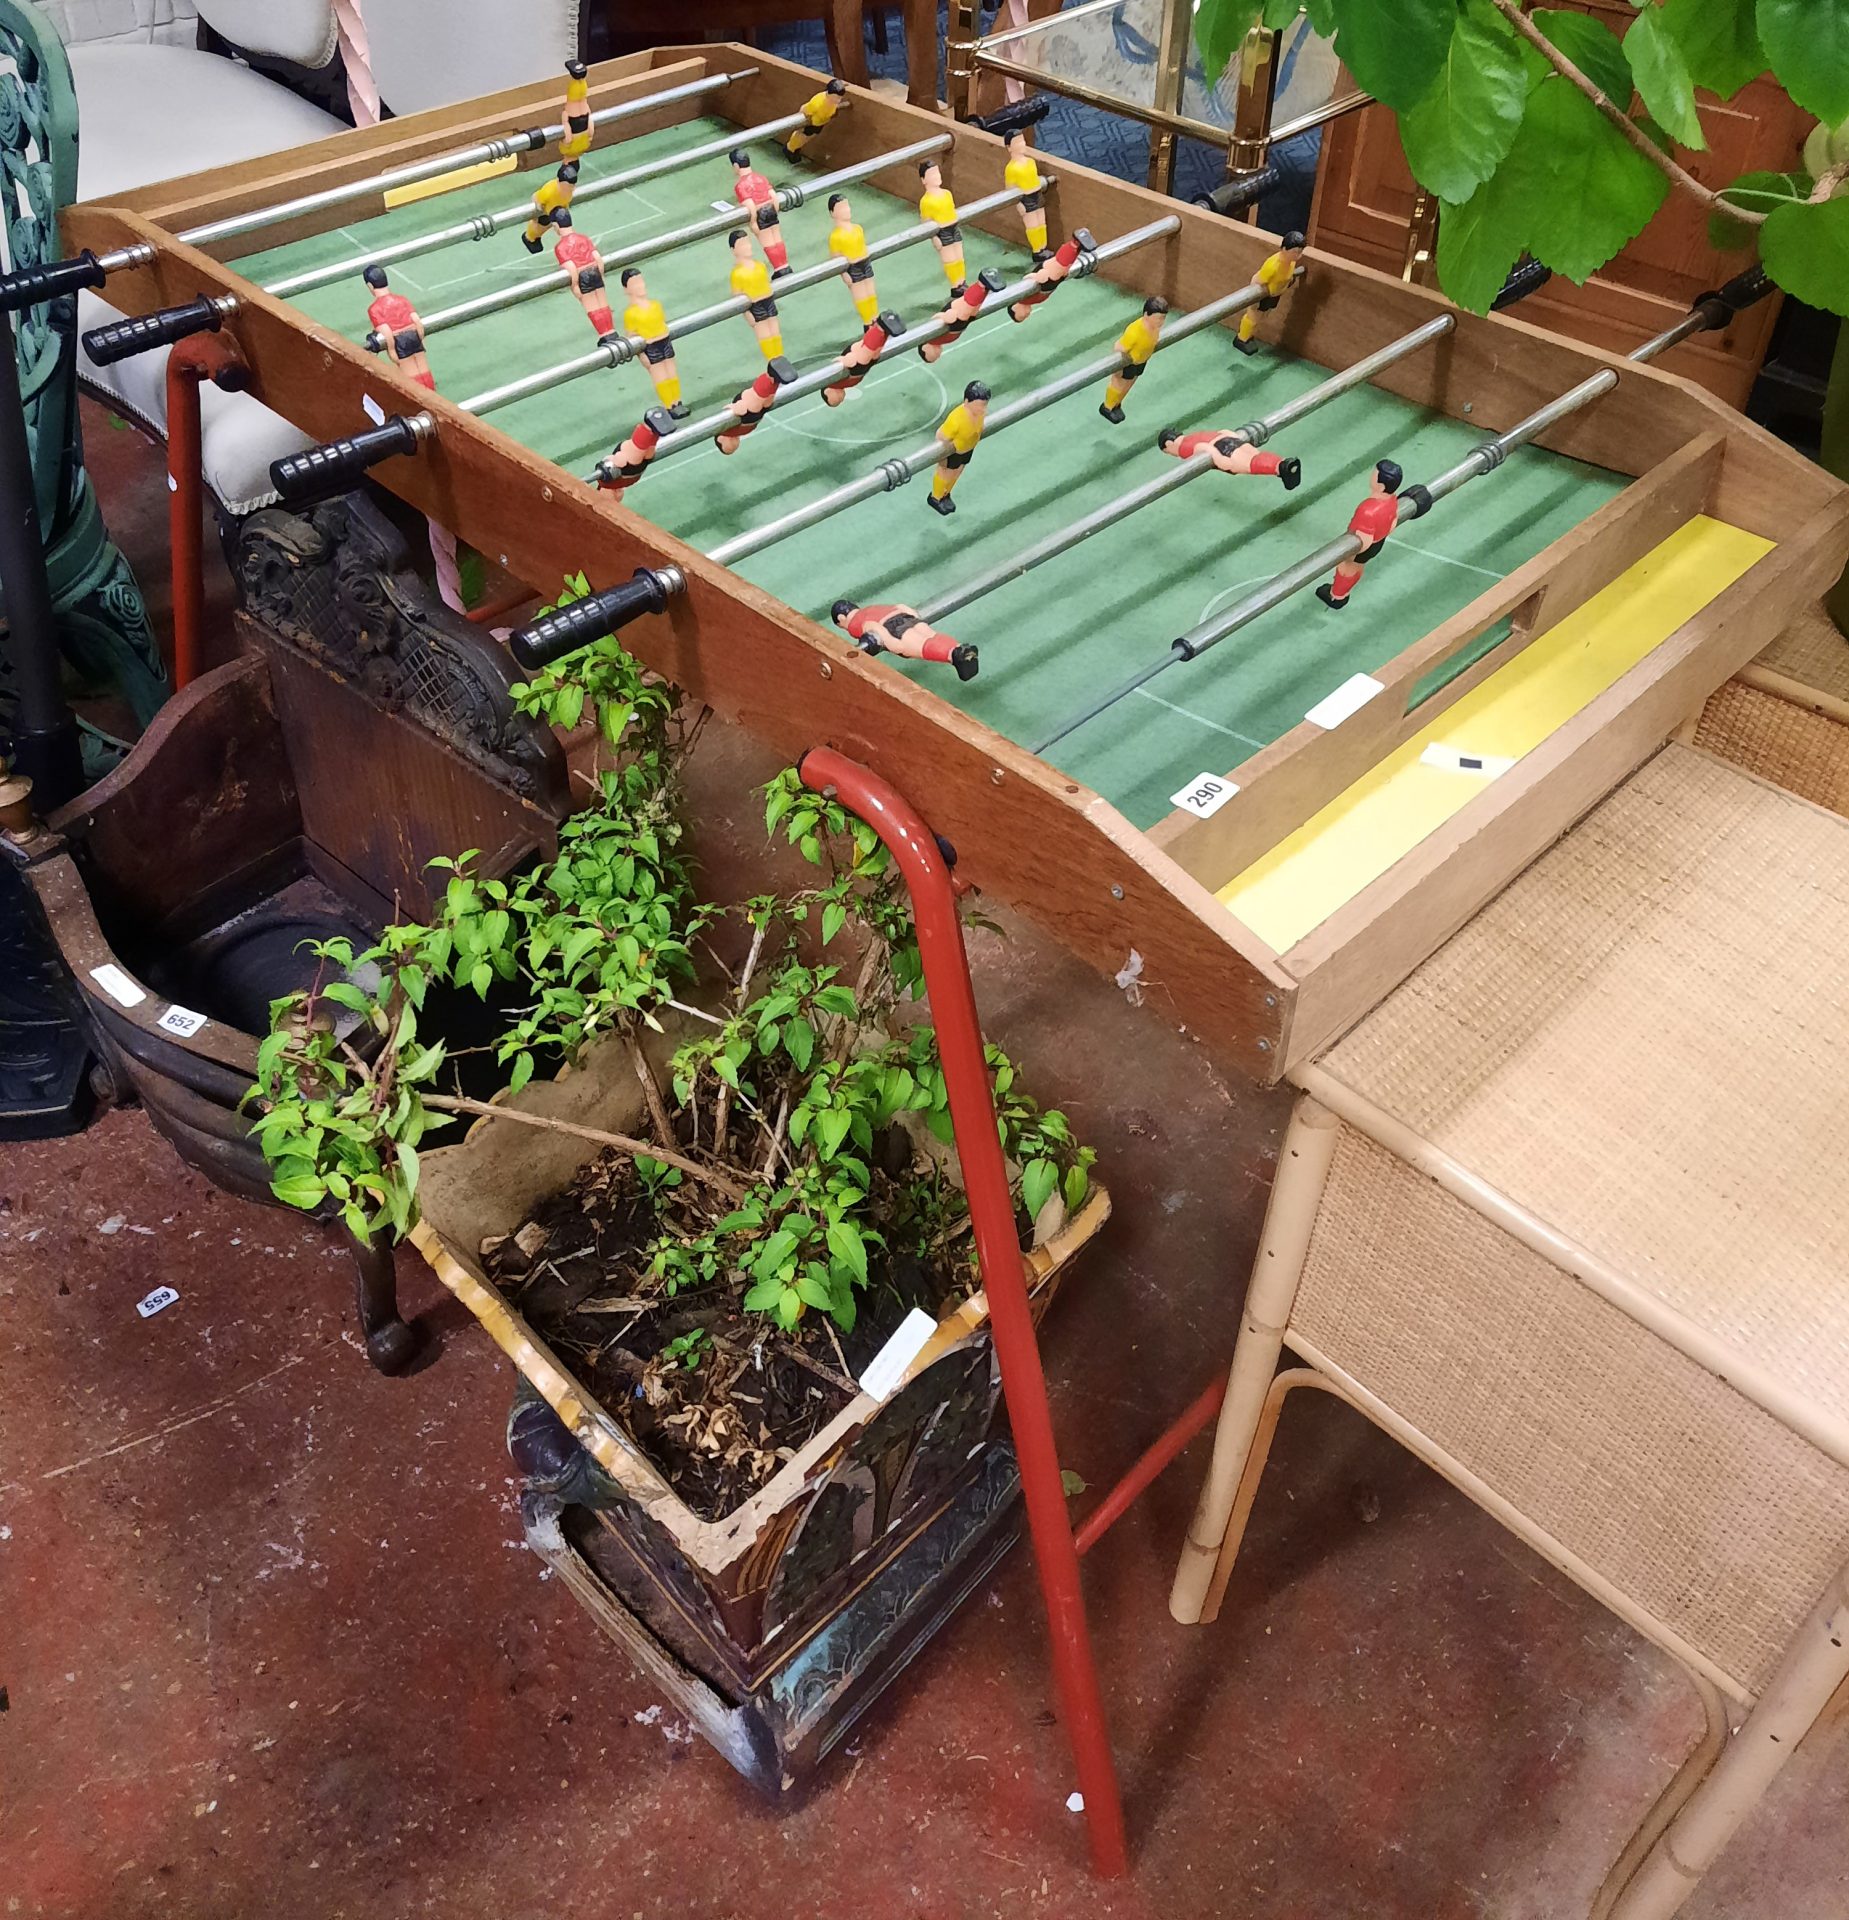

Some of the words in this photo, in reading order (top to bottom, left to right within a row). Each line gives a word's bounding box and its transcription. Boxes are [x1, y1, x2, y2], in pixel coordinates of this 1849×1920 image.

[1187, 782, 1223, 807] 290
[167, 1014, 195, 1029] 652
[144, 1291, 170, 1311] 655
